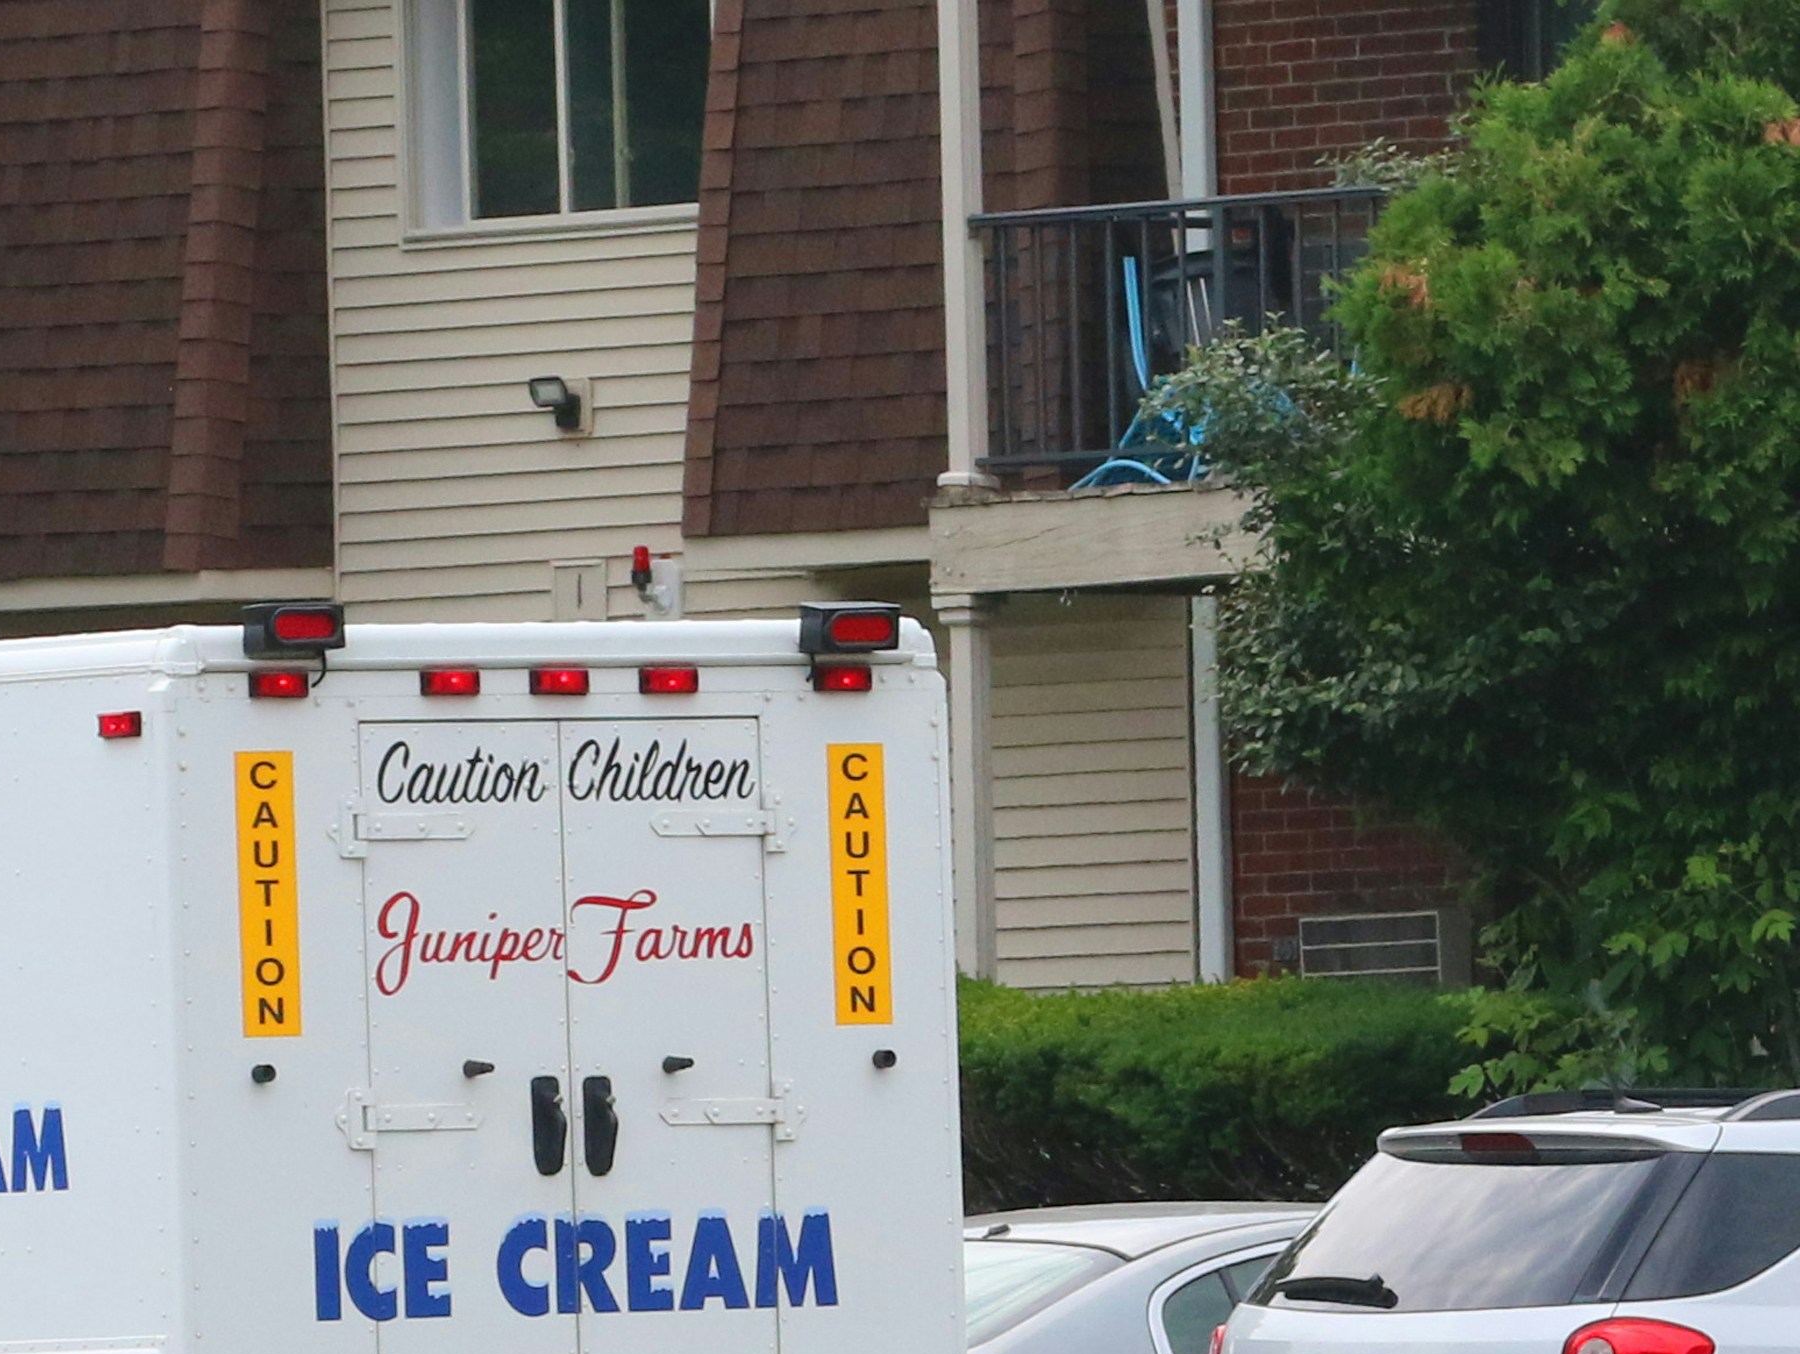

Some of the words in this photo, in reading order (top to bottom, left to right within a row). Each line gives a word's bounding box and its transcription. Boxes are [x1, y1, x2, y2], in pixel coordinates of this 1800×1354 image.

[376, 739, 552, 804] Caution
[567, 736, 757, 804] Children
[249, 760, 286, 1025] CAUTION
[841, 752, 877, 1013] CAUTION
[375, 890, 565, 997] Juniper
[566, 888, 754, 985] Farms
[313, 1214, 453, 1322] ICE
[496, 1205, 840, 1317] CREAM
